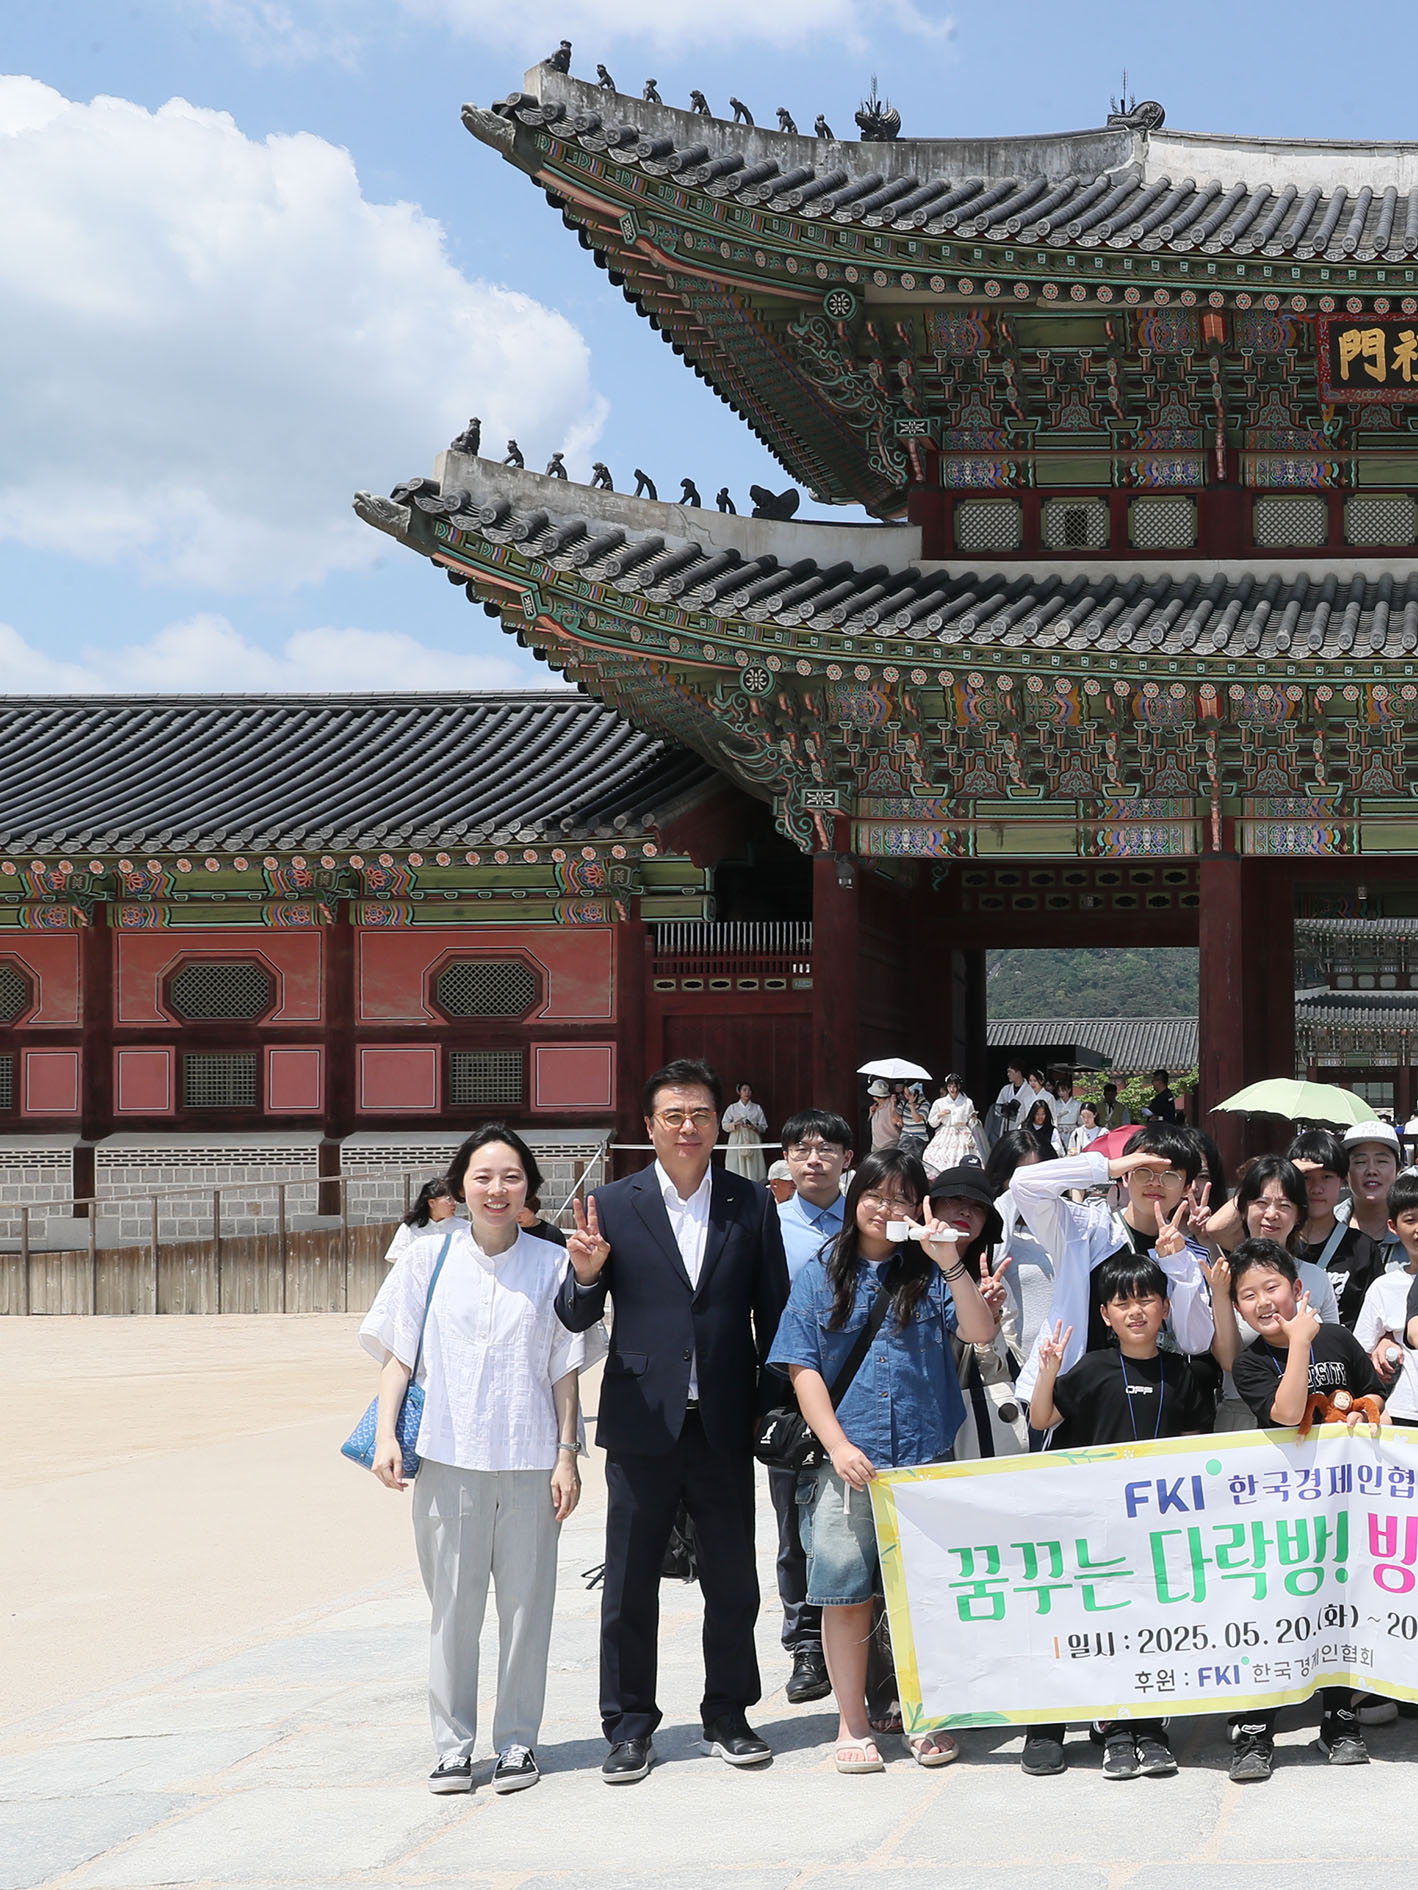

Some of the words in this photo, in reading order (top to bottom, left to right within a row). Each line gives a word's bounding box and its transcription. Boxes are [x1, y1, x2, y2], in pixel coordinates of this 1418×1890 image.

[1125, 1475, 1205, 1518] FKI
[947, 1538, 1135, 1622] 꿈꾸는
[1149, 1510, 1349, 1604] 다락방!
[1198, 1664, 1241, 1688] FKI
[1252, 1643, 1374, 1684] 한국경제인협회
